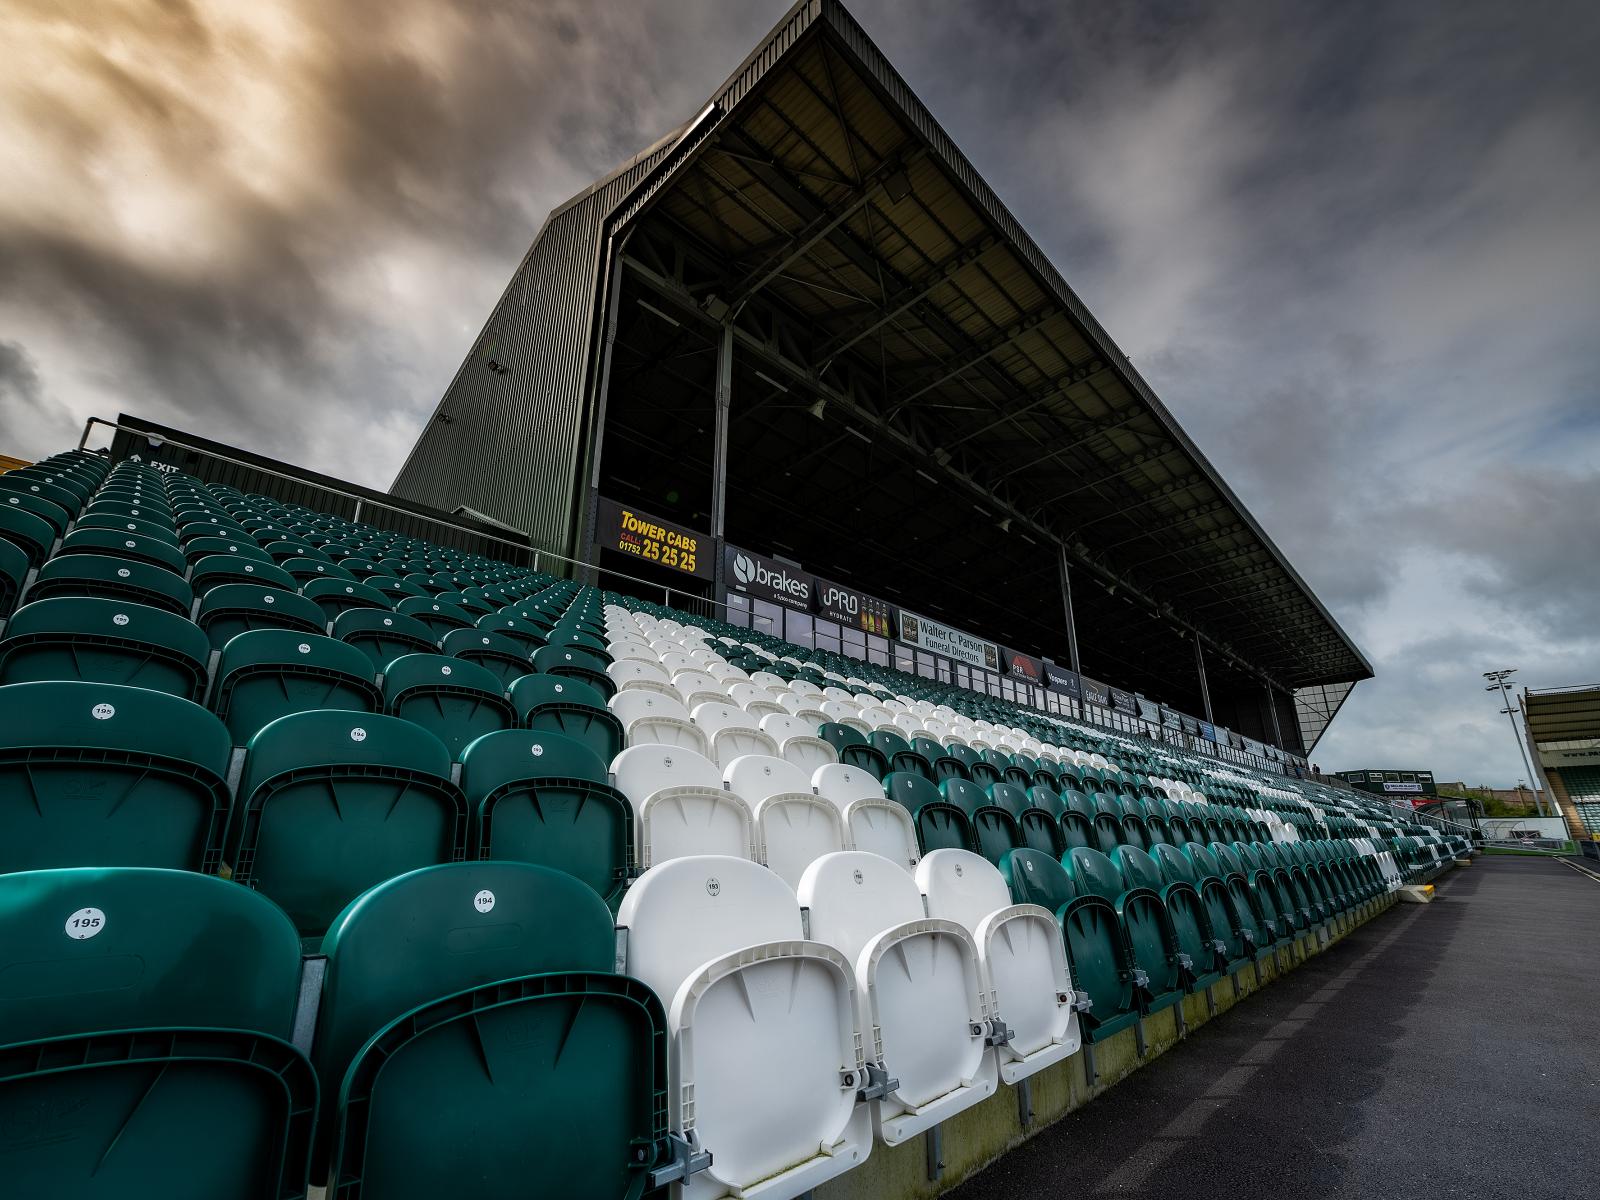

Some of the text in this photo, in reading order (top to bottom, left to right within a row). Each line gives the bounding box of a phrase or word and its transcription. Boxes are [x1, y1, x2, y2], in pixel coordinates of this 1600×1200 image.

[151, 461, 180, 473] EXIT
[622, 511, 697, 552] TOWER CABS
[619, 539, 696, 572] 01752 25 25 25
[756, 560, 809, 599] brakes
[919, 620, 947, 641] Walter
[958, 635, 983, 653] Parson
[925, 636, 951, 654] Funeral
[951, 645, 980, 664] Directors
[477, 897, 493, 905] 194
[73, 918, 101, 928] 195
